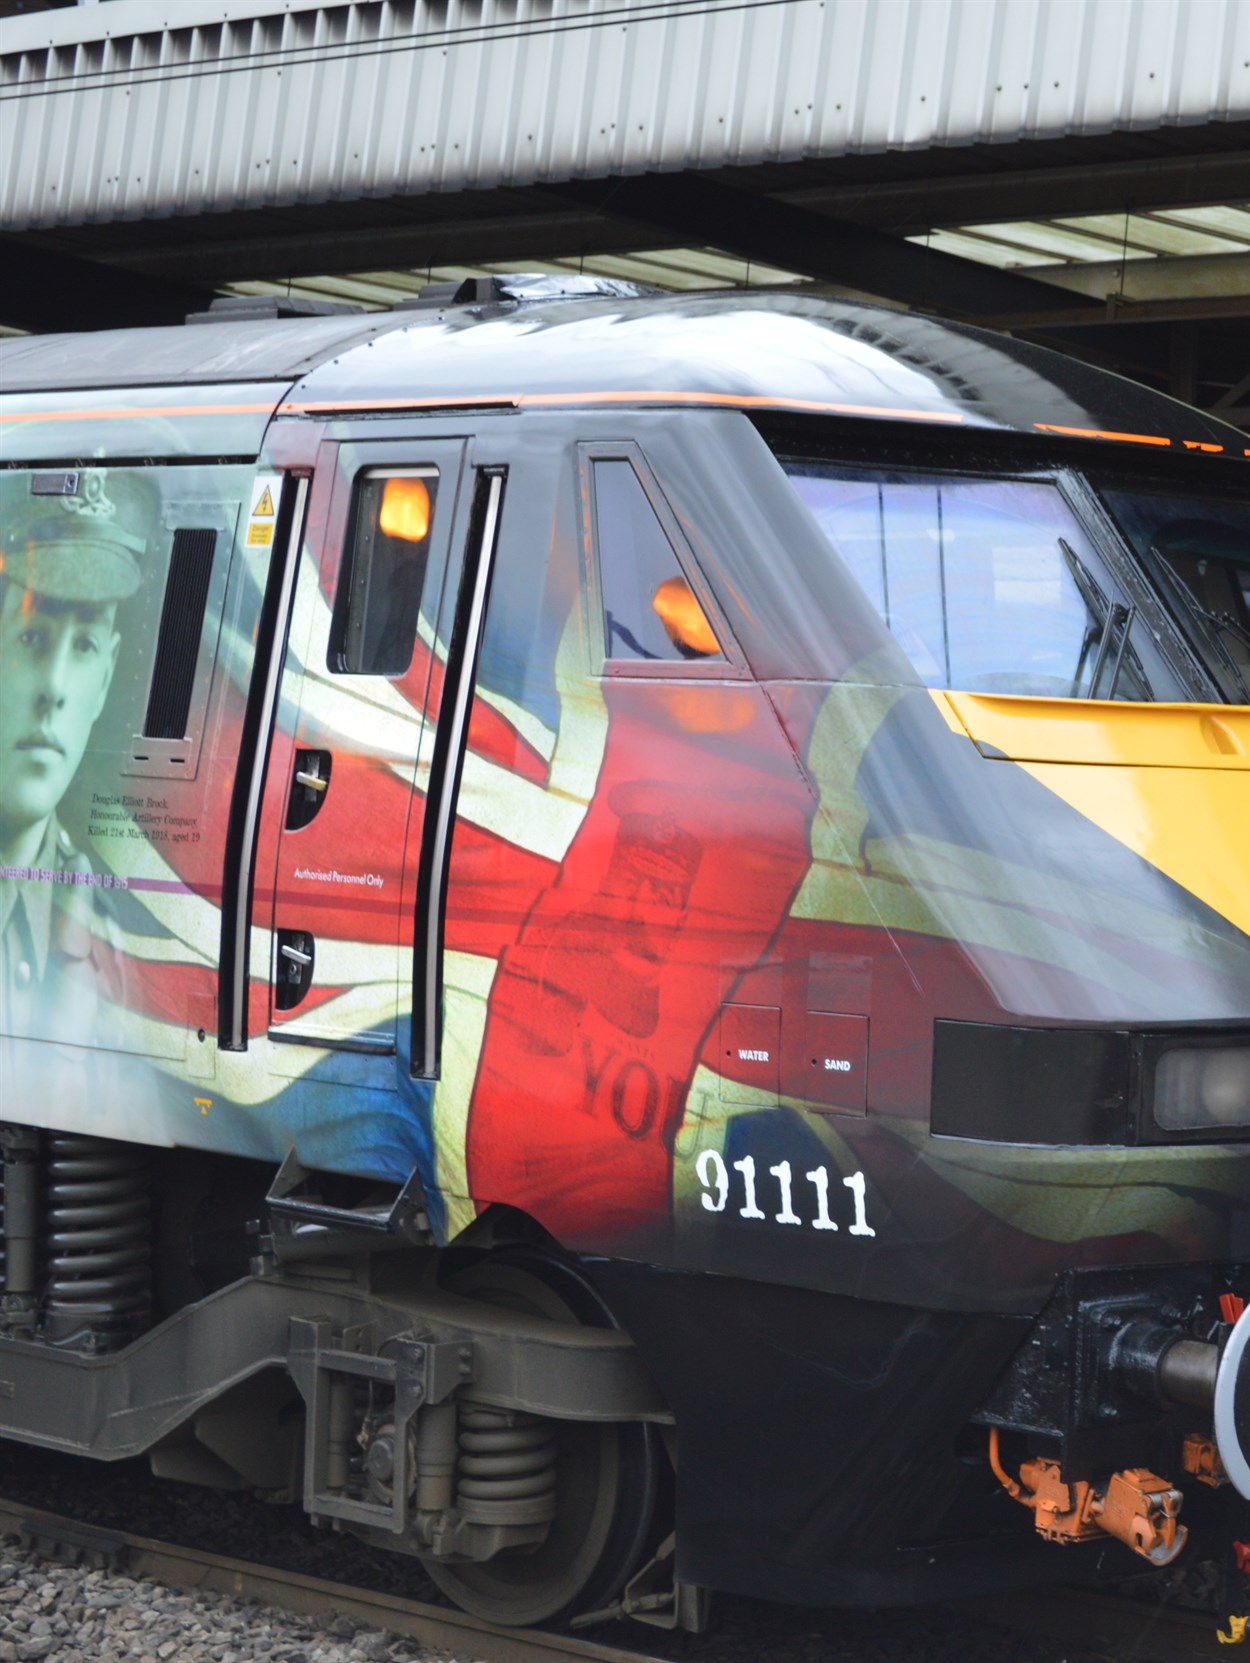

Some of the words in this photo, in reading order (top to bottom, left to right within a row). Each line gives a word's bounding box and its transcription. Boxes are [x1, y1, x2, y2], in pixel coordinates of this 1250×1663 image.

[132, 812, 161, 827] Artillery
[88, 826, 108, 837] Killed
[127, 829, 149, 840] March
[172, 833, 189, 842] aged
[191, 833, 201, 842] 19
[31, 868, 40, 880] TO
[41, 869, 63, 883] SERVE
[64, 871, 74, 885] BY
[75, 872, 88, 887] THE
[89, 873, 103, 888] END
[104, 875, 113, 889] OF
[294, 867, 332, 882] Authorised
[332, 870, 367, 885] Personnel
[367, 873, 385, 889] Only
[738, 1049, 769, 1062] WATER
[824, 1059, 851, 1072] SAND
[696, 1149, 876, 1237] 91111
